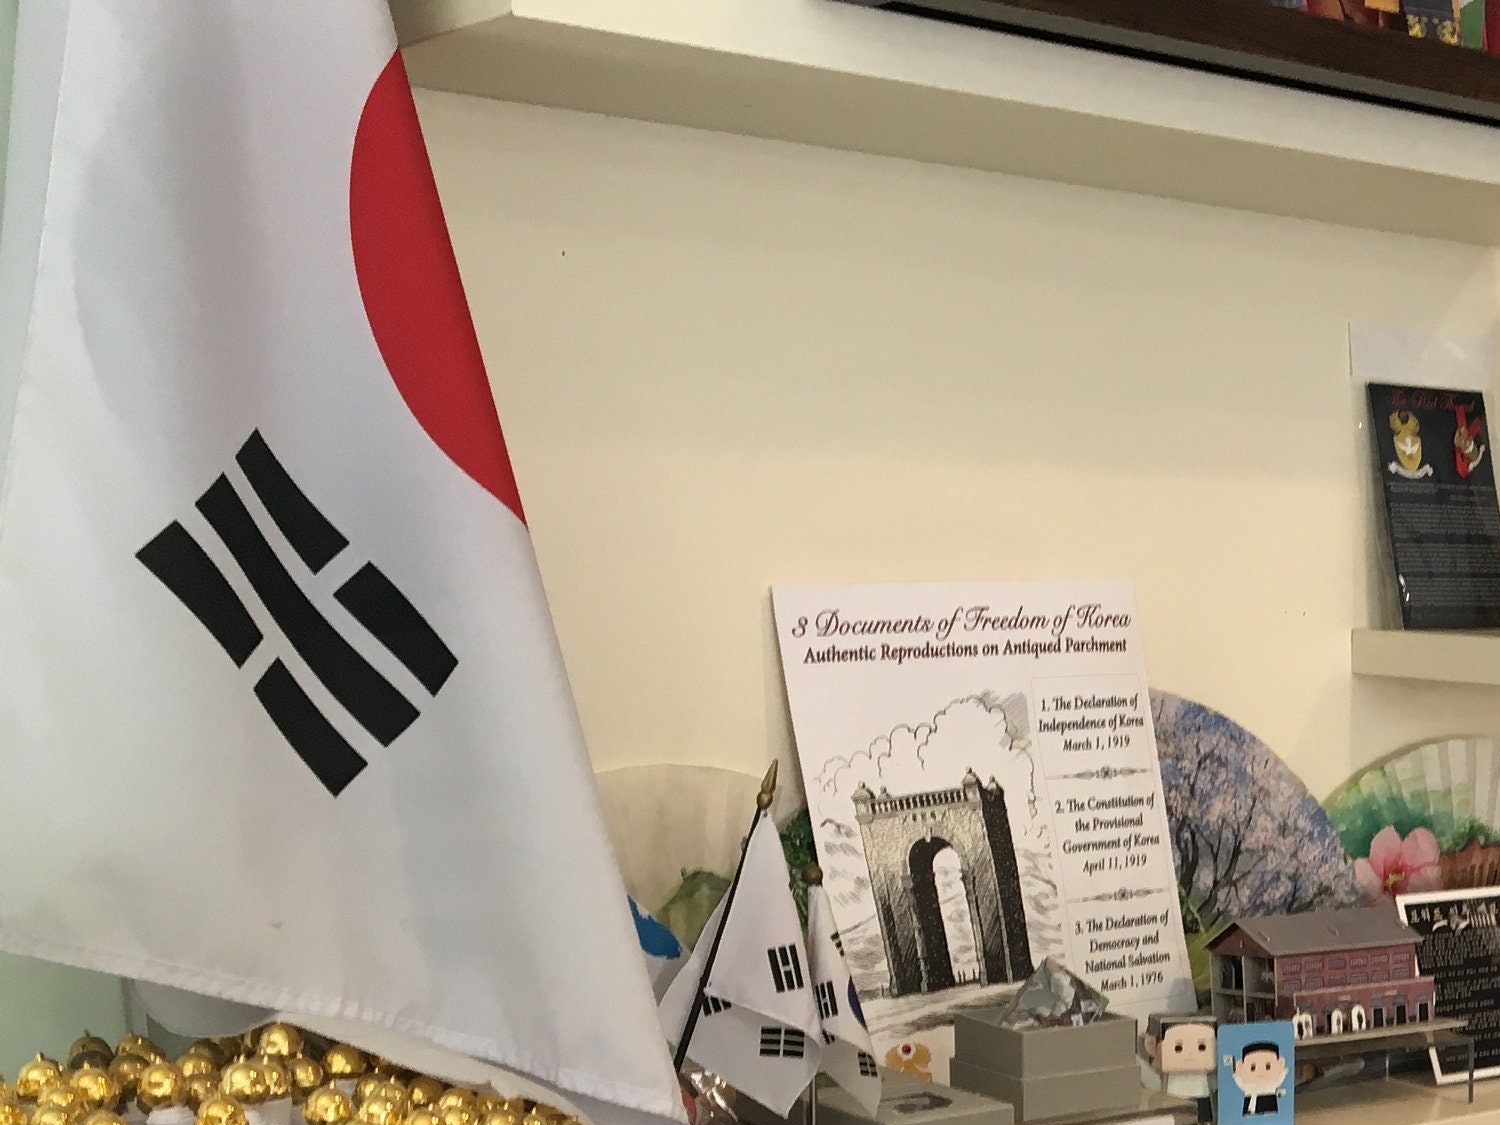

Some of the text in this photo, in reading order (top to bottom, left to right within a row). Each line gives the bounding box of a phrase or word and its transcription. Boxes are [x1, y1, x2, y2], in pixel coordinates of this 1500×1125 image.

[792, 603, 1132, 641] 3 Documents of Freedom of Korea
[803, 635, 1127, 665] Authentic Reproductions on Antiqued Parchment
[1052, 696, 1072, 711] The
[1074, 693, 1128, 711] Declaration
[1130, 693, 1138, 710] of
[1039, 714, 1144, 736] Independence of Korea
[1063, 738, 1092, 752] March
[1108, 735, 1130, 749] 1919
[1066, 799, 1086, 814] The
[1087, 795, 1144, 812] Constitution
[1146, 792, 1155, 810] of
[1075, 812, 1143, 833] the Provisional
[1062, 833, 1160, 855] Government of Korea
[1082, 858, 1105, 877] April
[1125, 853, 1147, 868] 1919
[1086, 918, 1103, 933] The
[1105, 913, 1158, 931] Declaration
[1159, 908, 1169, 927] of
[1089, 930, 1160, 954] Democracy and
[1085, 951, 1171, 974] National Salvation
[1100, 976, 1127, 992] March
[1141, 970, 1164, 986] 1976
